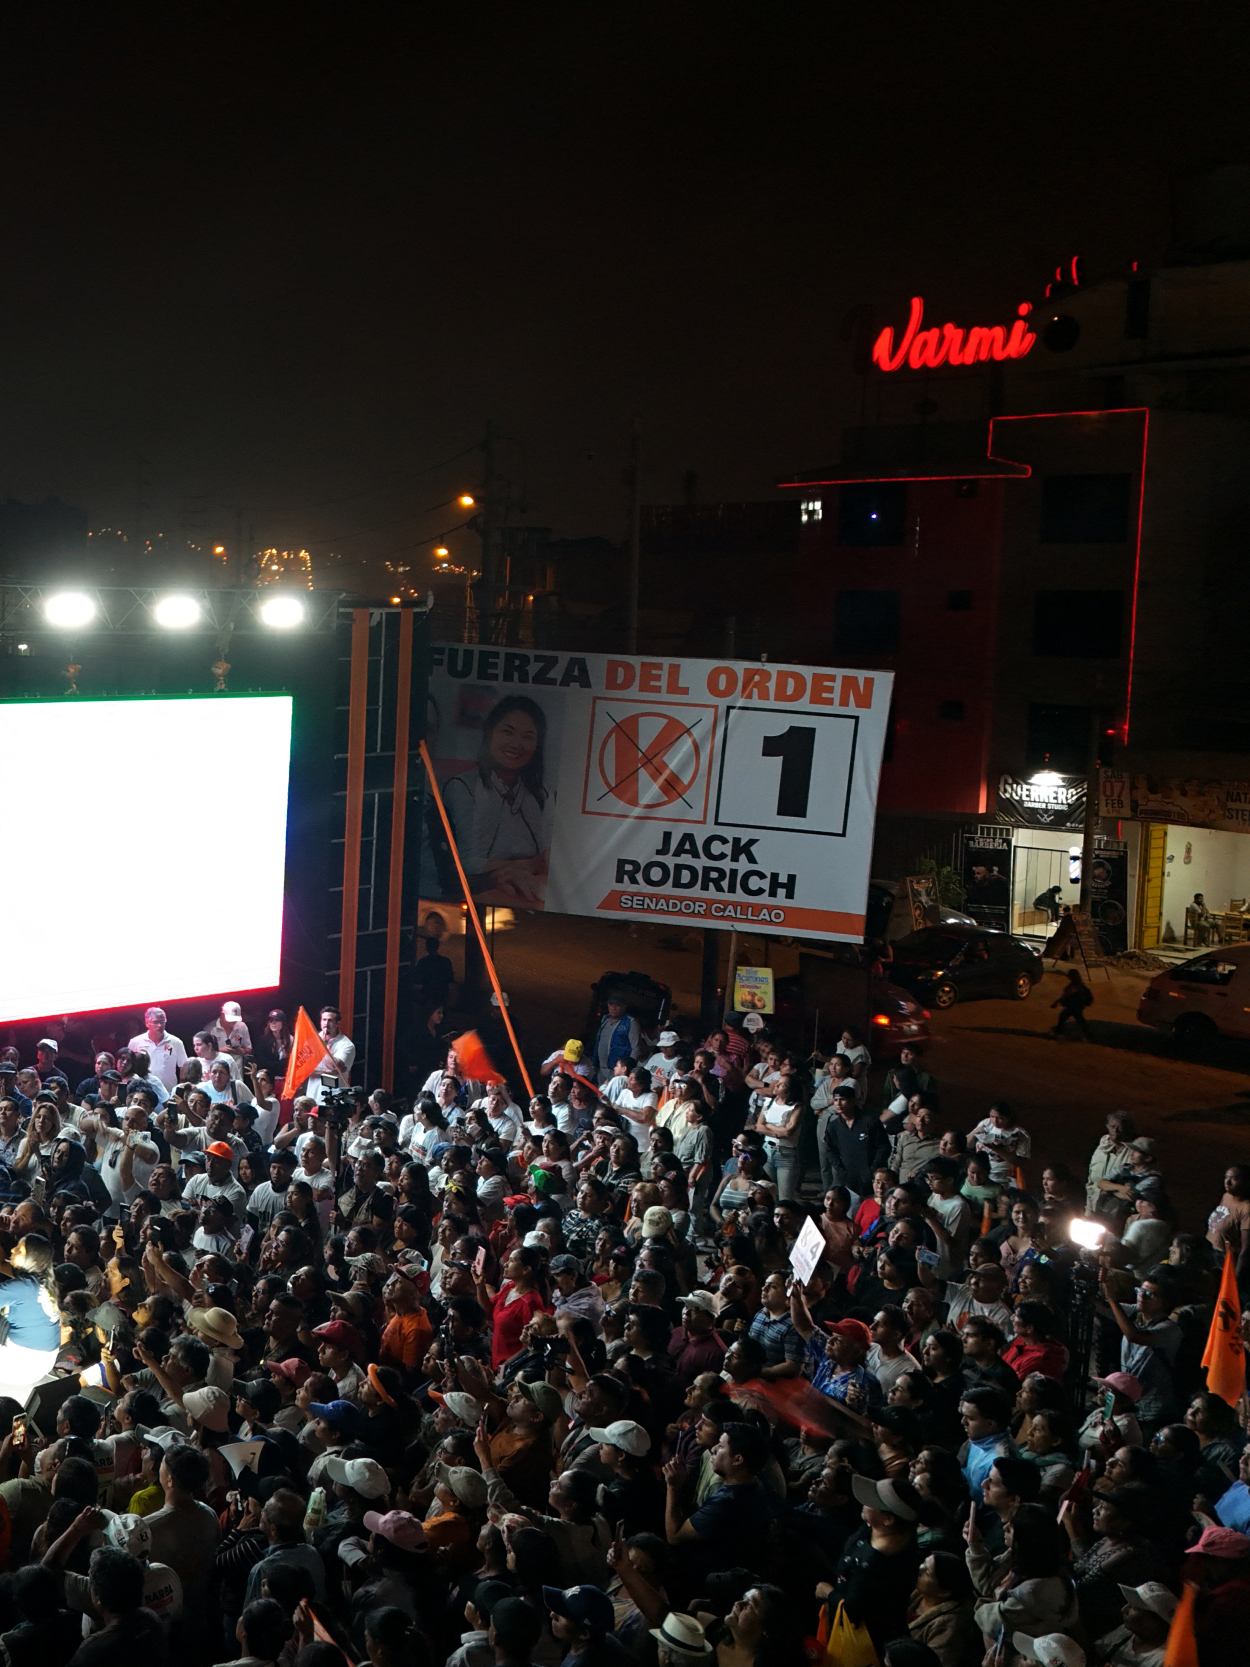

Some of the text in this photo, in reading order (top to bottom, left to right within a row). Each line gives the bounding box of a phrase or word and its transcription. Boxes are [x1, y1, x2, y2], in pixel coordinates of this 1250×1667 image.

[605, 659, 690, 696] DEL
[707, 666, 875, 710] ORDEN
[762, 726, 816, 819] 1
[1102, 780, 1126, 799] 07
[1105, 798, 1124, 809] FEB
[656, 831, 760, 865] JACK
[615, 858, 797, 900] RODRICH
[620, 894, 785, 923] SENADOR CALLAO
